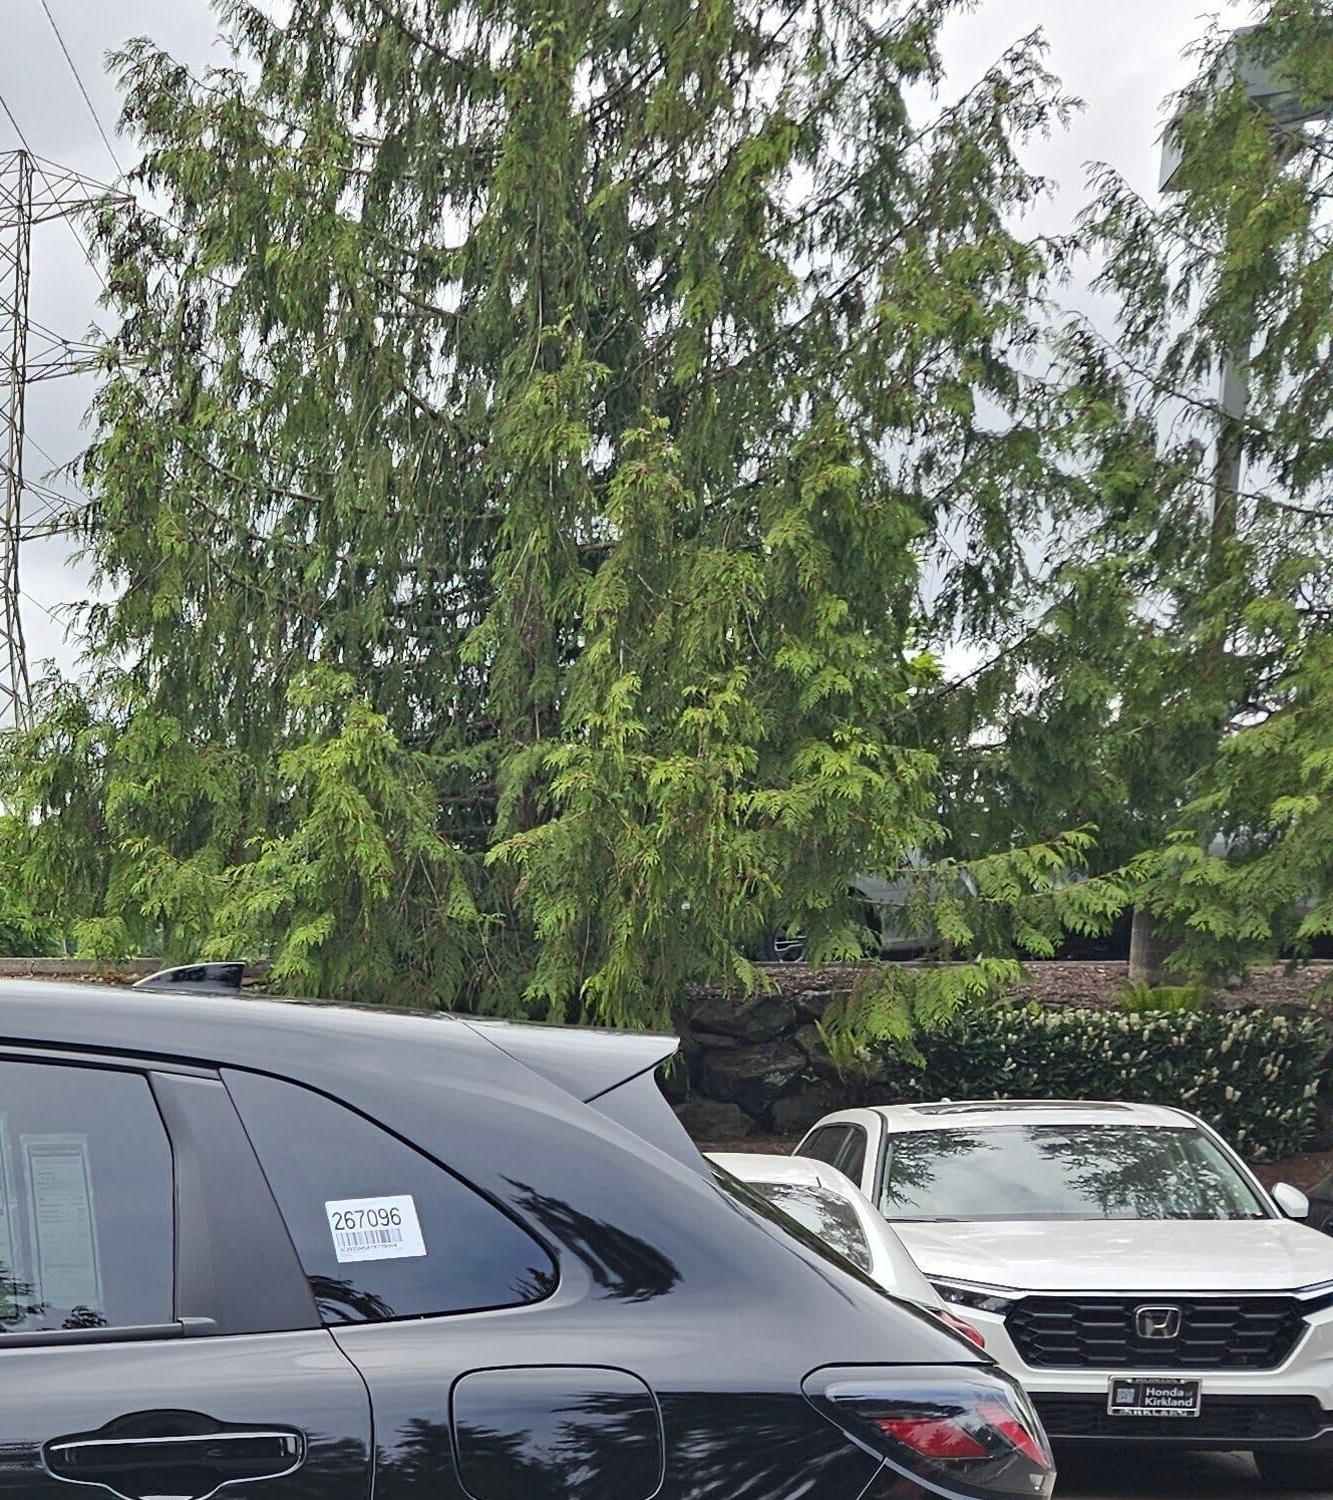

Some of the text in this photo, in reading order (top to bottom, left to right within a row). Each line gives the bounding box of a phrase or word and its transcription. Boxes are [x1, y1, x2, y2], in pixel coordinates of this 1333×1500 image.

[331, 1207, 402, 1231] 267096
[1146, 1387, 1184, 1397] Honda
[1144, 1397, 1193, 1407] Kirkland
